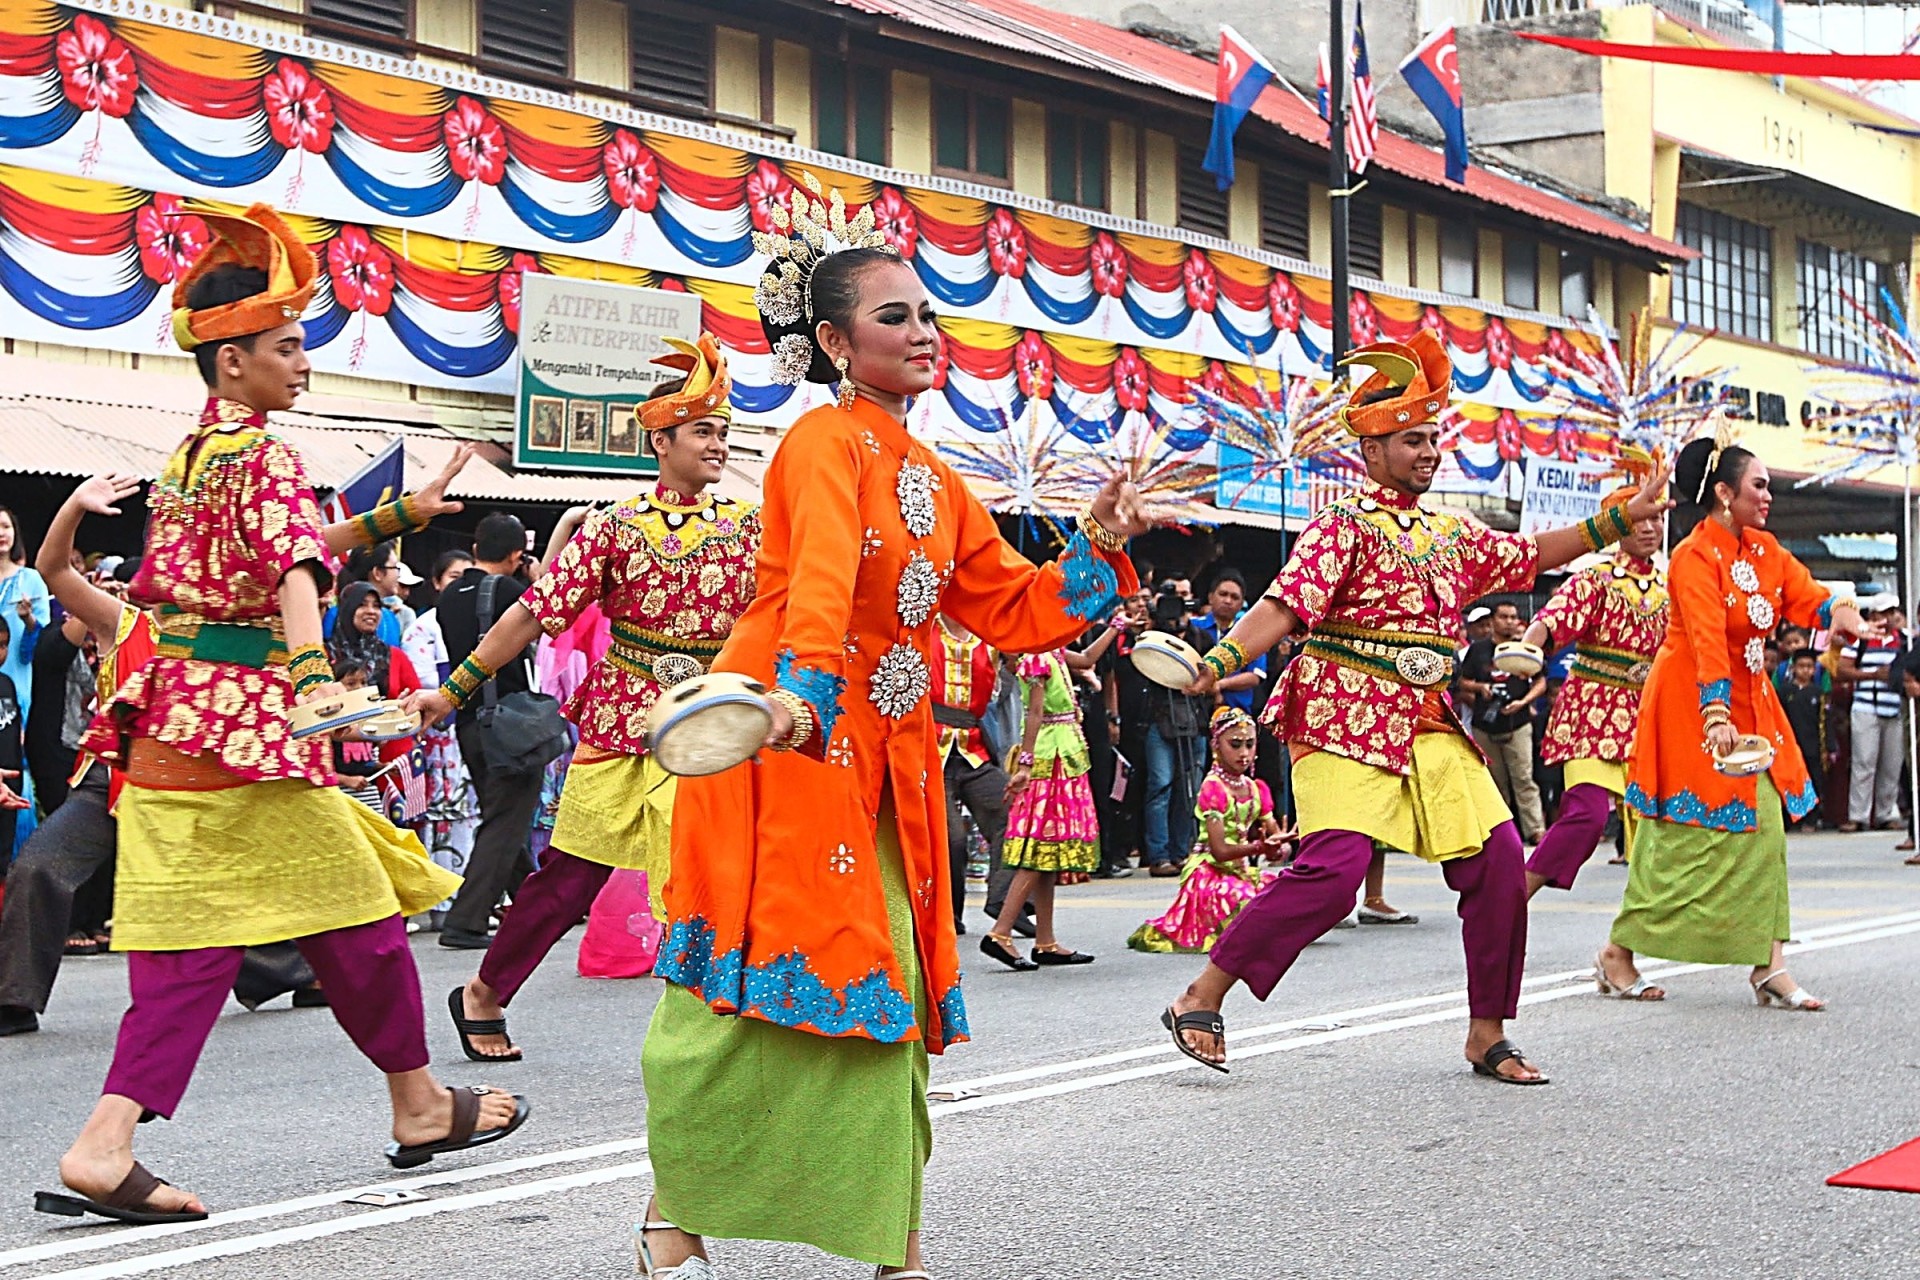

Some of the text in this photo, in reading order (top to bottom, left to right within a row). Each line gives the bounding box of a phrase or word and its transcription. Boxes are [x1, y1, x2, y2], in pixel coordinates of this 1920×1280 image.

[1763, 115, 1804, 165] 1961
[545, 294, 680, 329] ATIFFA KHIR
[531, 358, 593, 376] Mengambil
[596, 365, 651, 382] Tempahan
[1537, 467, 1575, 491] KEDAI
